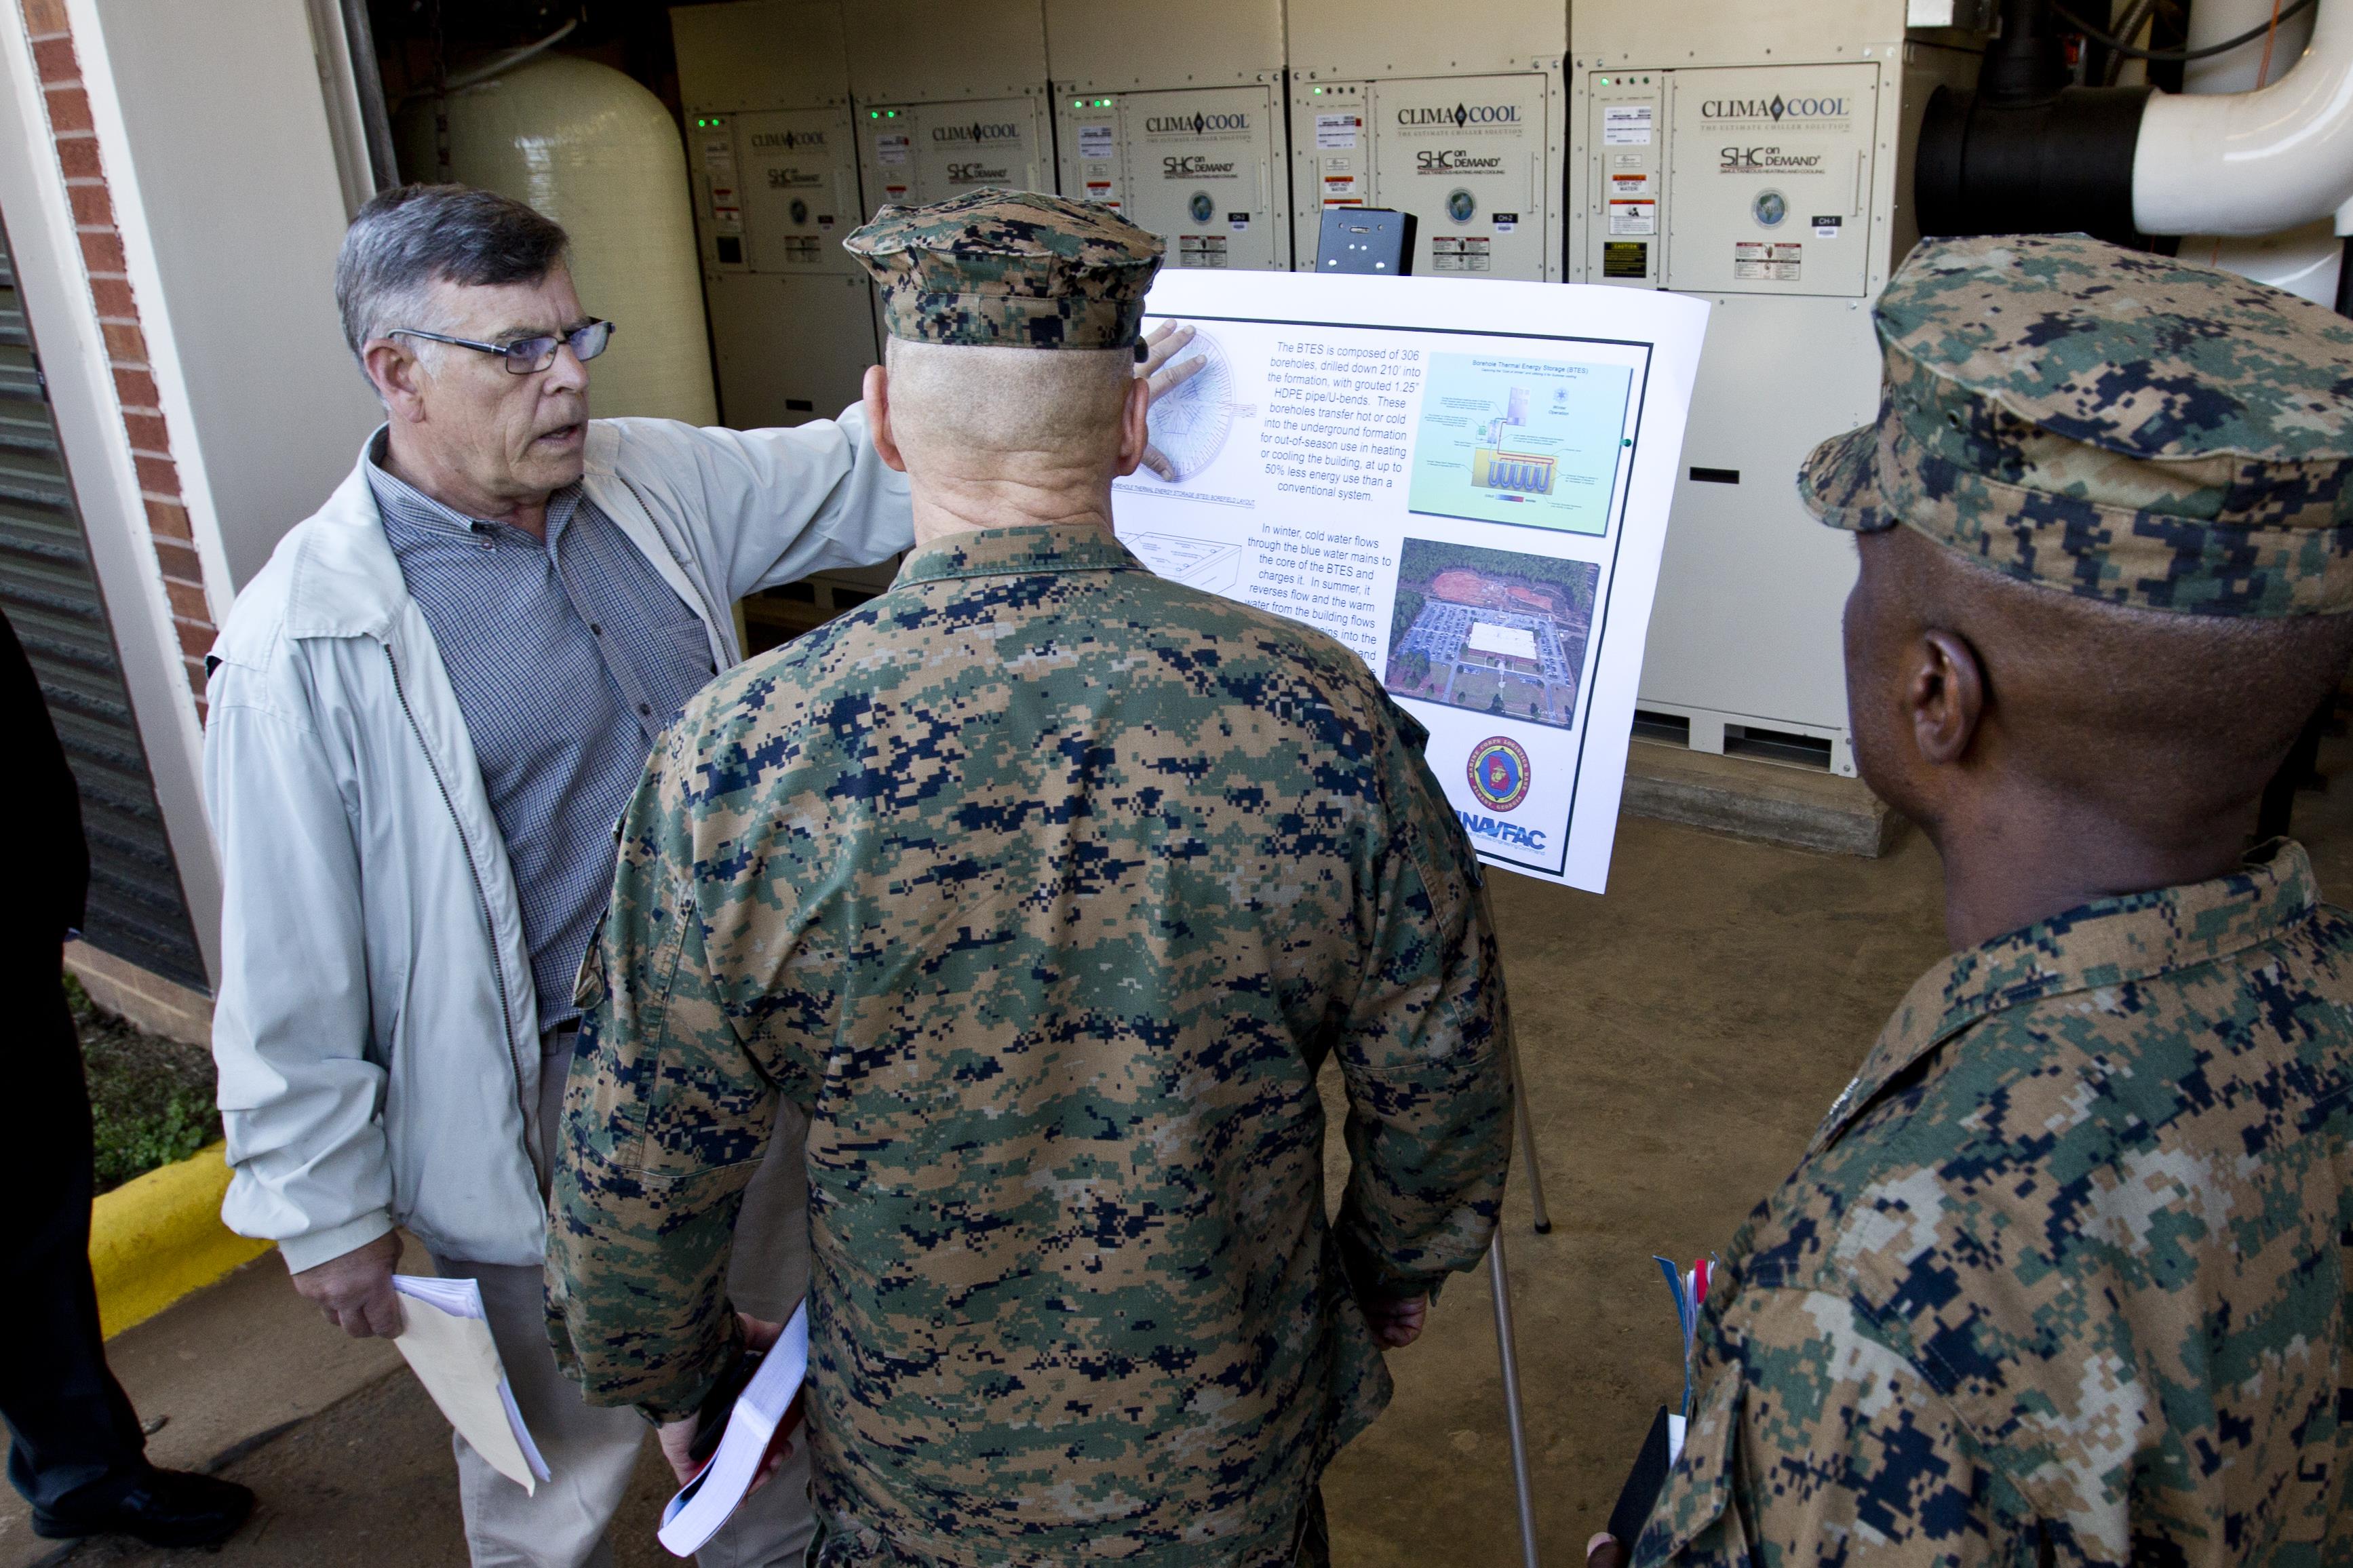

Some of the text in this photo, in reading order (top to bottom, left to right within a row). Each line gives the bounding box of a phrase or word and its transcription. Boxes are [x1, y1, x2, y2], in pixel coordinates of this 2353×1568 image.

[1163, 157, 1193, 172] SHC
[1417, 151, 1453, 168] SHC
[1721, 147, 1764, 166] SHC
[1277, 342, 1420, 361] The BTES is composed of 306
[1270, 357, 1317, 371] boreholes,
[1321, 361, 1349, 372] drilled
[1352, 364, 1377, 374] down
[1403, 367, 1421, 377] into
[1268, 372, 1281, 383] the
[1284, 374, 1330, 387] formation,
[1333, 378, 1352, 388] with
[1355, 380, 1392, 391] grouted
[1275, 388, 1406, 408] HDPE pipe/U-bends. These
[1270, 402, 1406, 425] boreholes transfer hot or cold
[1264, 418, 1407, 441] into the underground formation
[1260, 432, 1407, 459] for out-of-season use in heating
[1261, 449, 1402, 473] or cooling the building, at up to
[1265, 463, 1393, 488] 50% less energy use than a
[1277, 482, 1374, 502] conventional system.
[1262, 523, 1379, 549] In winter, cold water flows
[1247, 537, 1392, 566] through the blue water mains to
[1259, 553, 1374, 580] the core of the BTES and
[1259, 570, 1294, 584] charges
[1311, 576, 1320, 587] In
[1322, 580, 1361, 595] summer,
[1364, 585, 1370, 595] it
[1249, 584, 1375, 612] reverses flow and the warm
[1245, 599, 1376, 628] water from the building flows
[1341, 630, 1359, 642] into
[1361, 633, 1377, 645] the
[1359, 650, 1376, 661] and
[1462, 812, 1547, 850] NAVFAC
